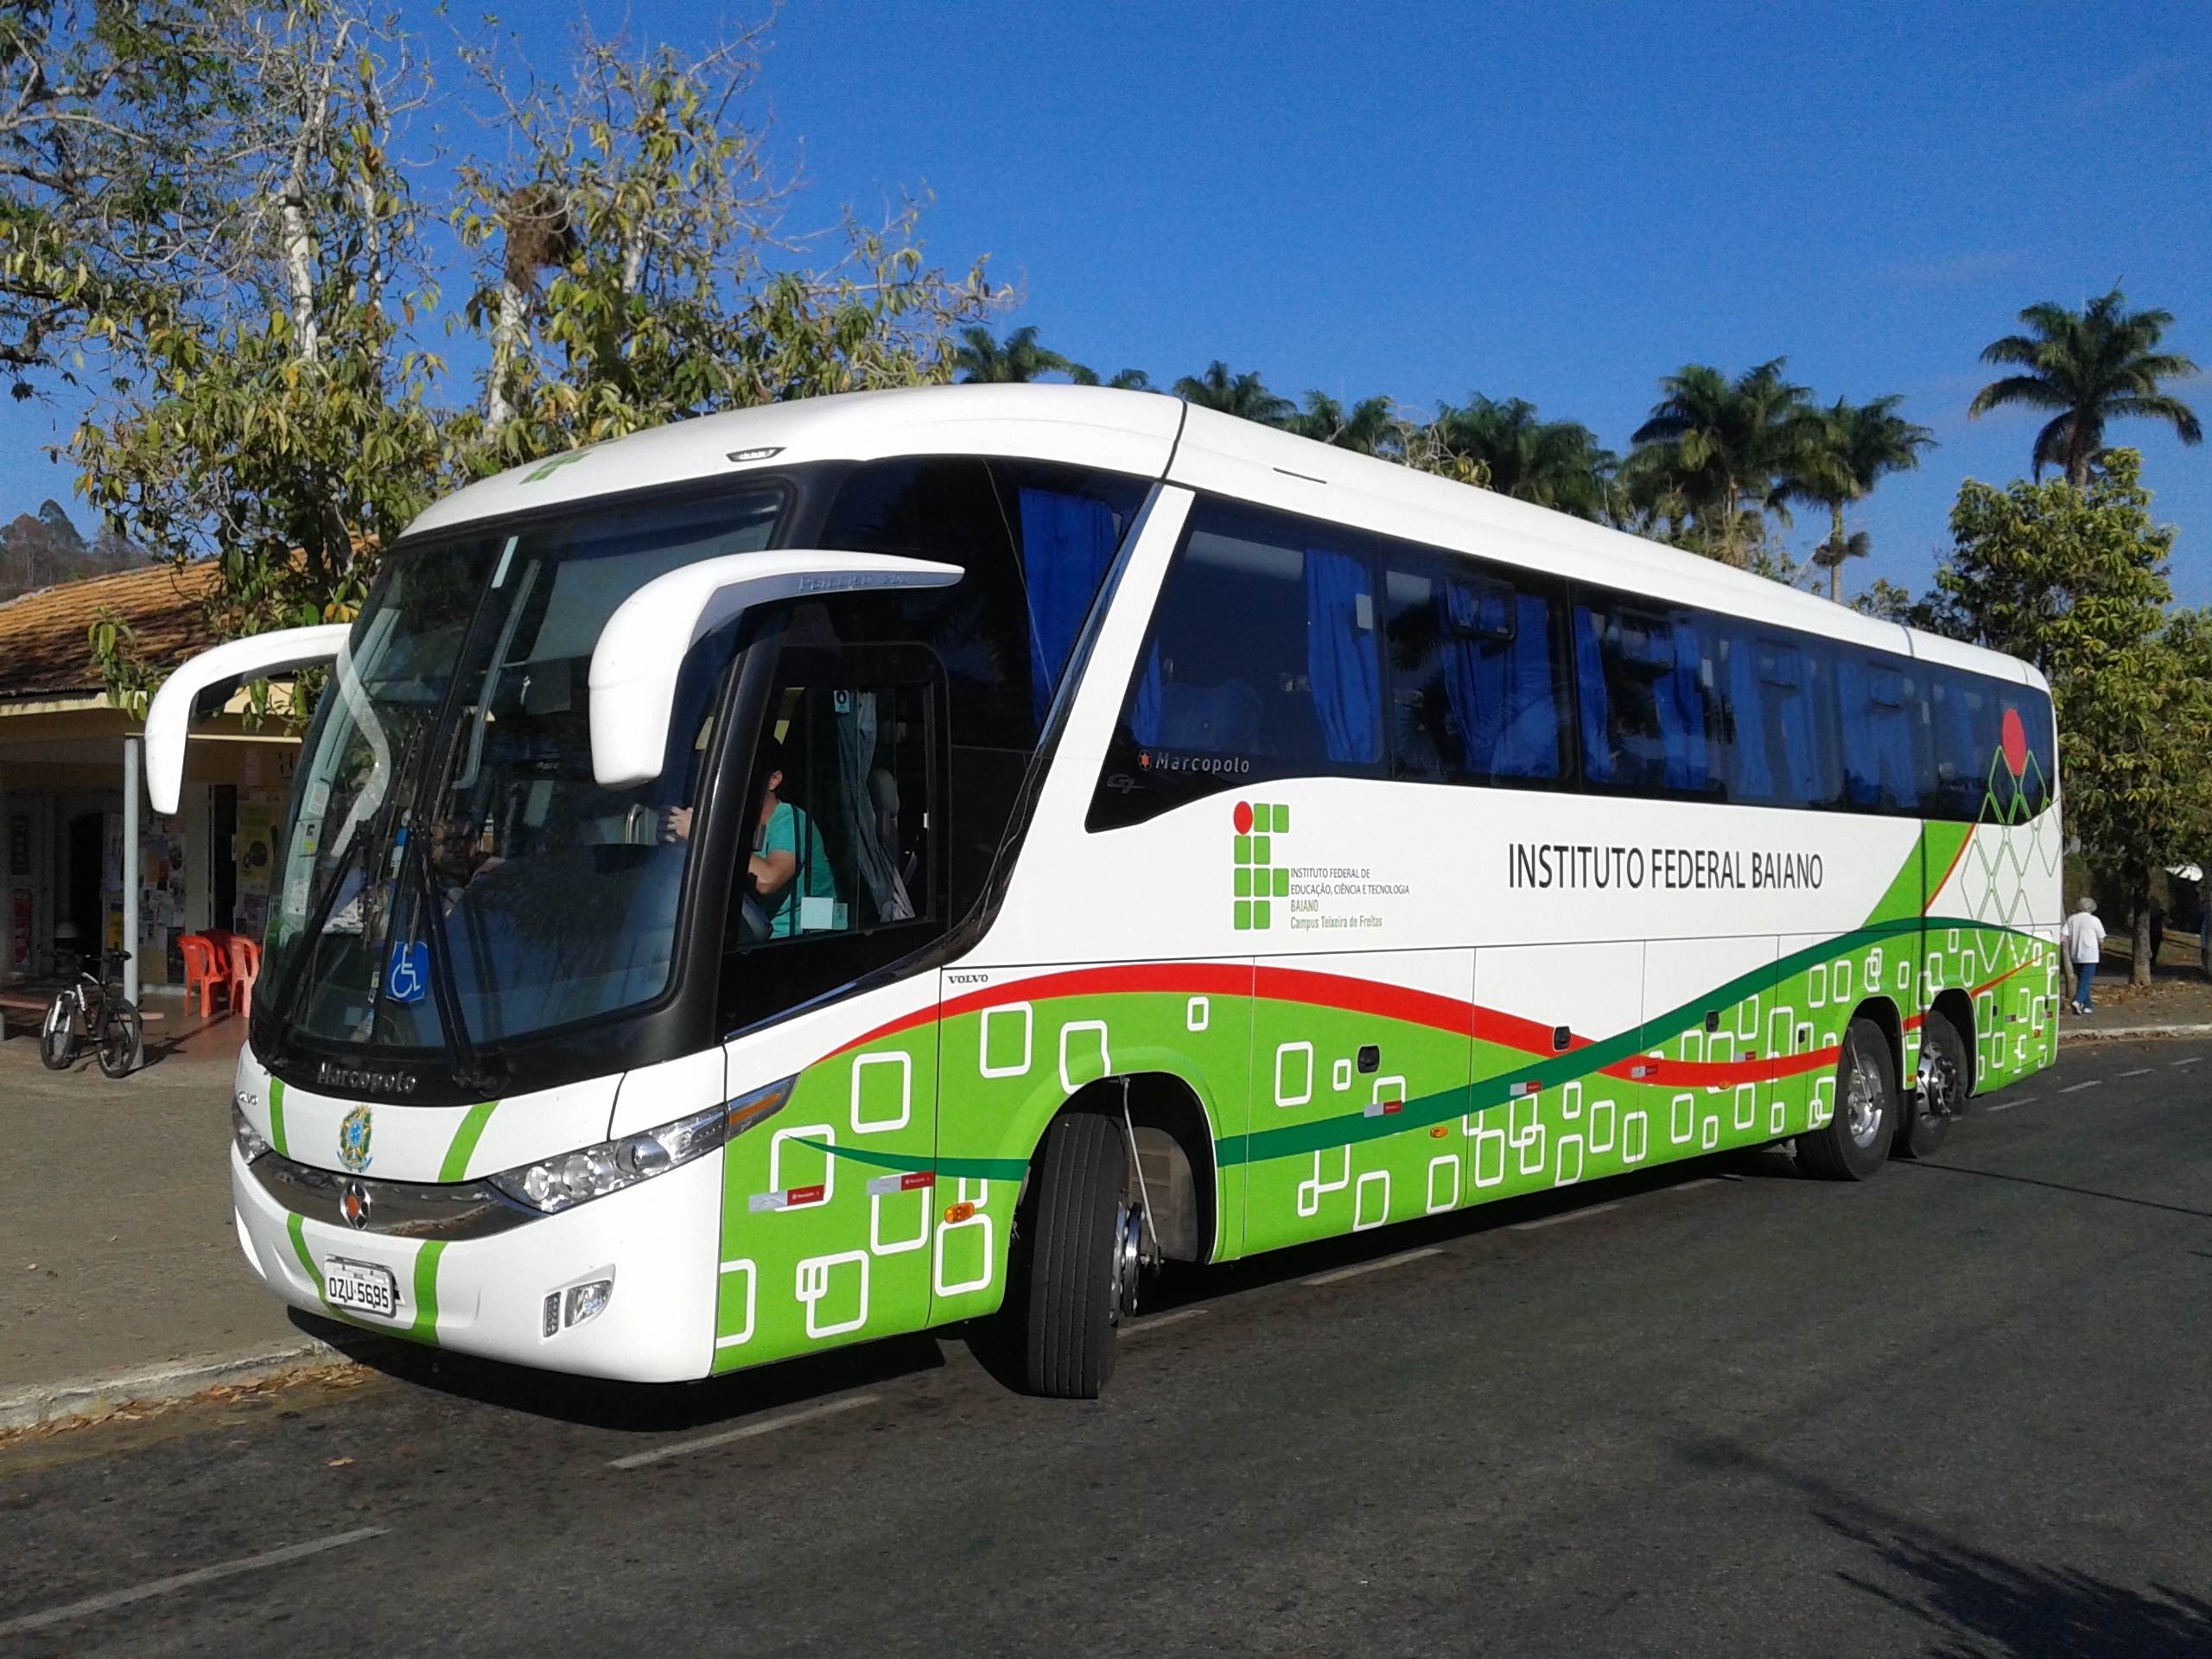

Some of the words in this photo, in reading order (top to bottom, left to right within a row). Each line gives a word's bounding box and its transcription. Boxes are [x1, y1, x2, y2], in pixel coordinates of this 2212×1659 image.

[1155, 752, 1249, 774] Marcopolo
[1290, 868, 1329, 879] INSTITUTO
[1329, 868, 1360, 879] FEDERAL
[1361, 868, 1370, 879] DE
[1510, 843, 1644, 889] INSTITUTO
[1652, 849, 1745, 889] FEDERAL
[1751, 851, 1823, 889] BAIANO
[1290, 882, 1333, 897] EDUCAÇÃO,
[1333, 882, 1362, 895] CIÊNCIA
[1368, 884, 1410, 895] TECNOLOGIA
[1290, 899, 1319, 912] BAIANO
[1290, 916, 1319, 931] Campus
[1321, 915, 1348, 929] Teixeira
[1349, 915, 1358, 929] de
[1359, 914, 1382, 928] Freitas
[948, 974, 988, 984] VOLVO
[316, 1061, 418, 1094] Marcopolo
